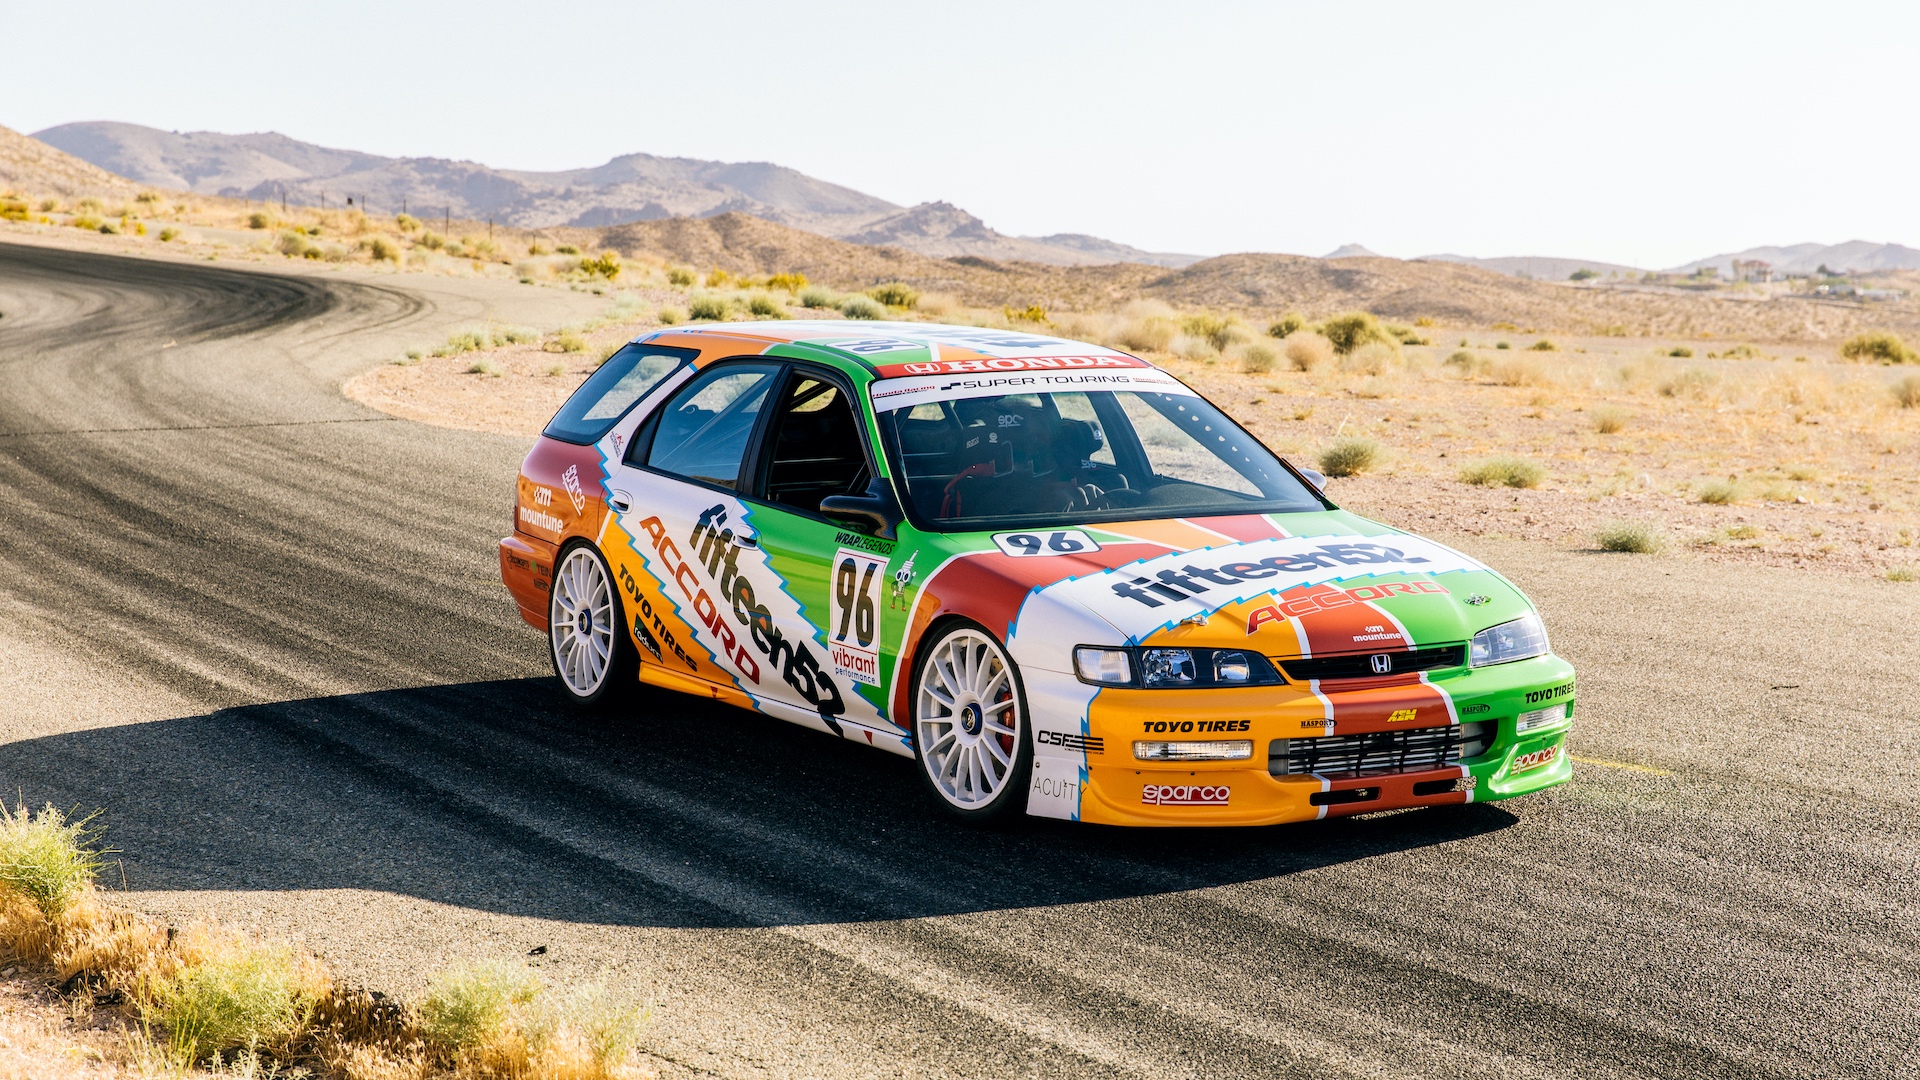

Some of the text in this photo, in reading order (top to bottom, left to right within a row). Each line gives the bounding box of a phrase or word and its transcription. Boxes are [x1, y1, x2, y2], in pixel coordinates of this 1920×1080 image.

[942, 356, 1131, 372] HONDA
[963, 375, 1130, 389] SUPER TOURING
[562, 464, 586, 517] sparco
[520, 506, 564, 534] mountune
[1006, 532, 1084, 555] 96
[1111, 543, 1431, 609] fifteen52
[639, 515, 760, 686] ACCORD
[836, 557, 879, 647] 96
[1245, 581, 1452, 636] ACCORD
[619, 563, 698, 672] TOYO TIRES
[689, 503, 846, 738] fifteen52
[1352, 632, 1402, 642] mountune
[832, 650, 876, 675] vibrant
[835, 666, 876, 684] performance
[1525, 681, 1575, 704] TOYO TIRES
[1143, 720, 1251, 733] TOYO TIRES
[1387, 709, 1417, 722] AEM
[1037, 730, 1085, 748] CSF
[1511, 744, 1558, 774] sparco
[1142, 785, 1230, 805] sparco
